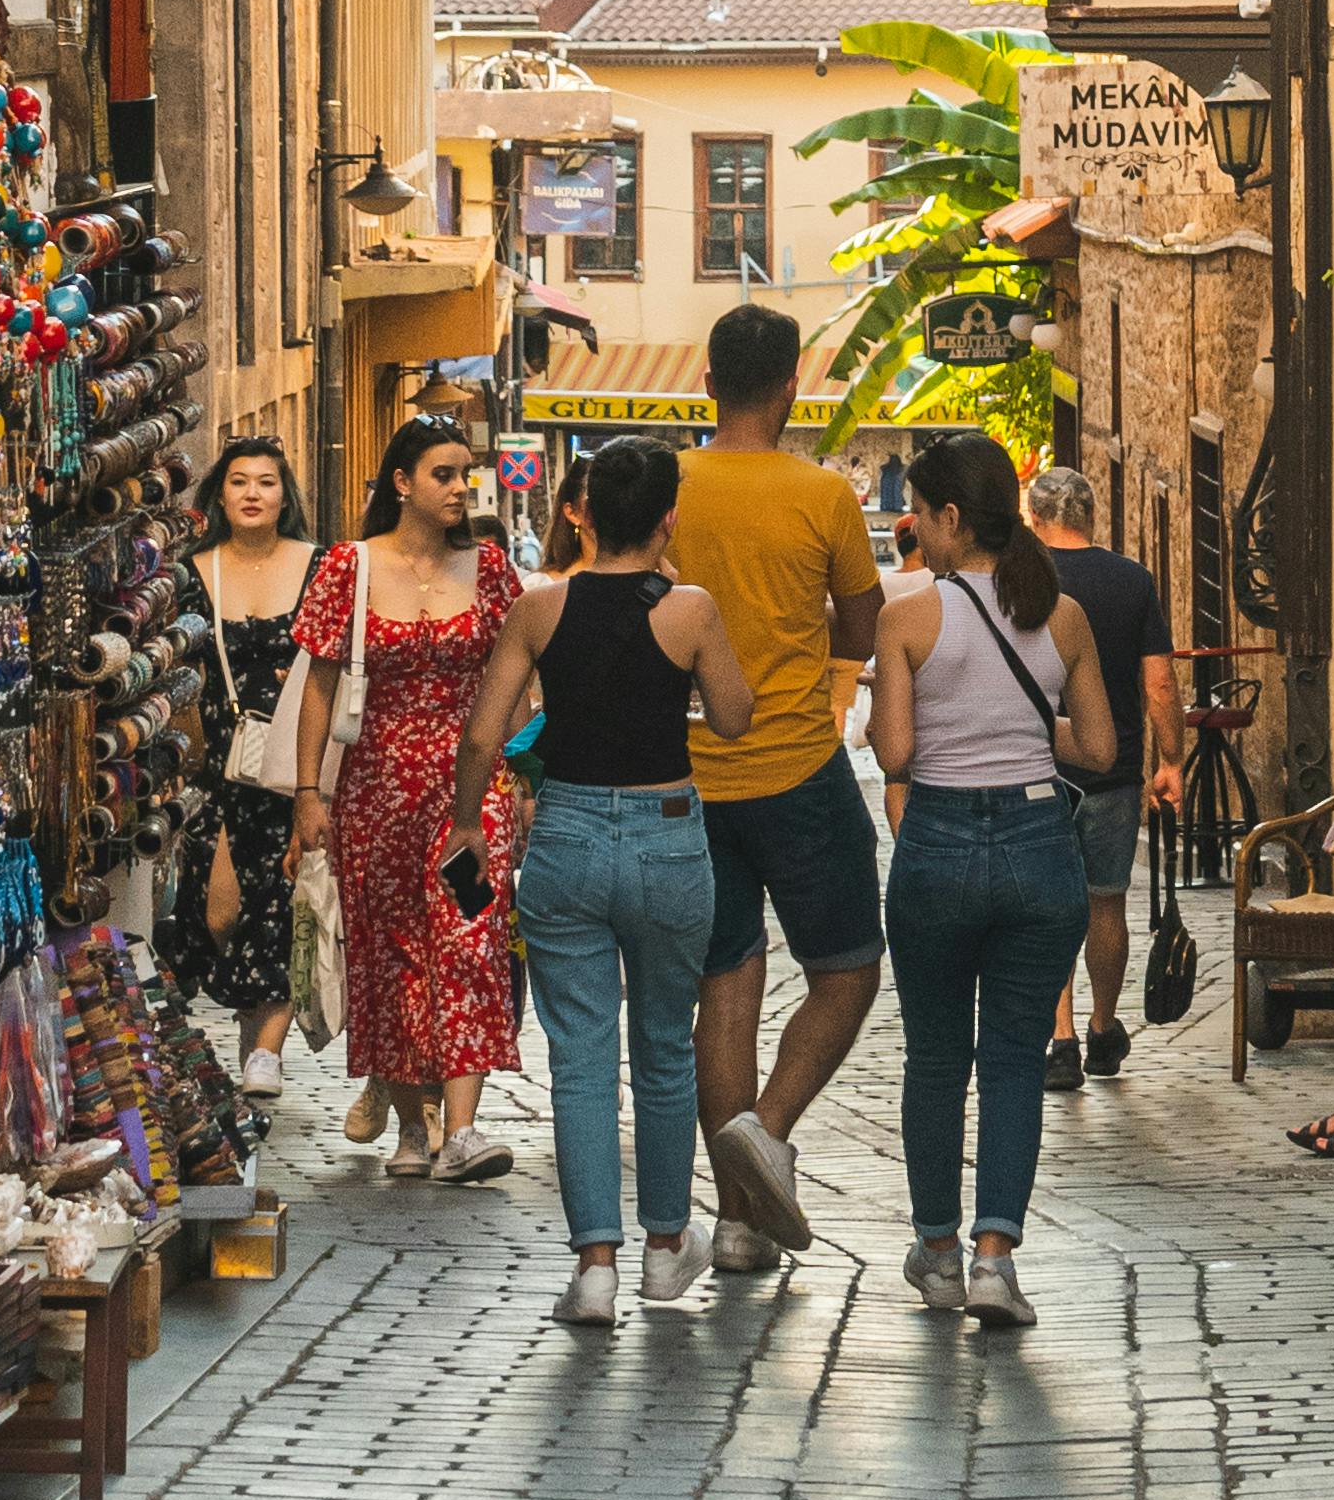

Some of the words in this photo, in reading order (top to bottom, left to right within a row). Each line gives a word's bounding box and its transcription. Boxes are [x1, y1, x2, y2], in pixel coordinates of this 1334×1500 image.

[1071, 74, 1189, 110] MEKÂN
[1053, 113, 1210, 149] MÜDAVİM
[548, 397, 711, 421] GÜLİZAR
[877, 404, 893, 421] &
